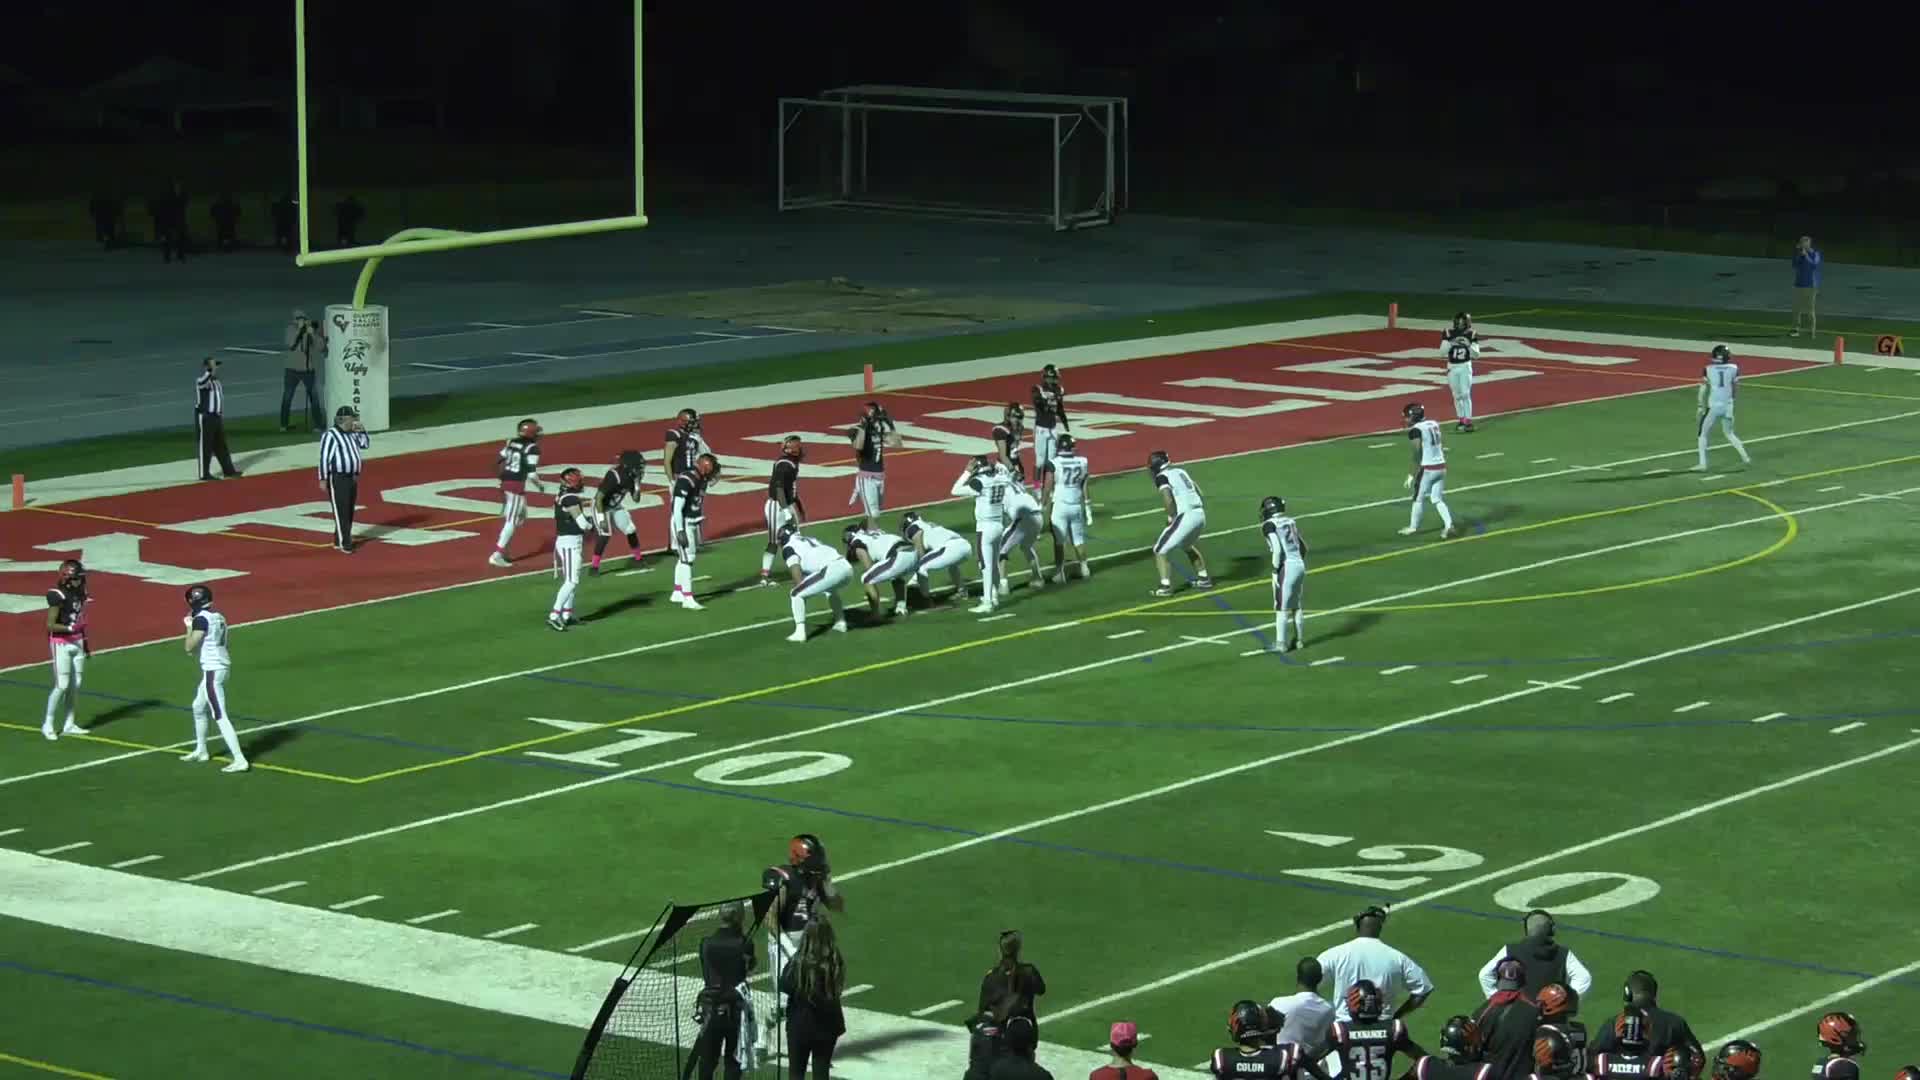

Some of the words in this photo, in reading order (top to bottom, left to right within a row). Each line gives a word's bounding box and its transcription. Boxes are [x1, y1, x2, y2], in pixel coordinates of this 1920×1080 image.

[344, 363, 368, 376] Ugly
[1718, 371, 1725, 388] 1
[523, 728, 853, 785] 10
[1280, 844, 1661, 915] 20
[1236, 1062, 1265, 1073] COLON
[1349, 1046, 1387, 1080] 35
